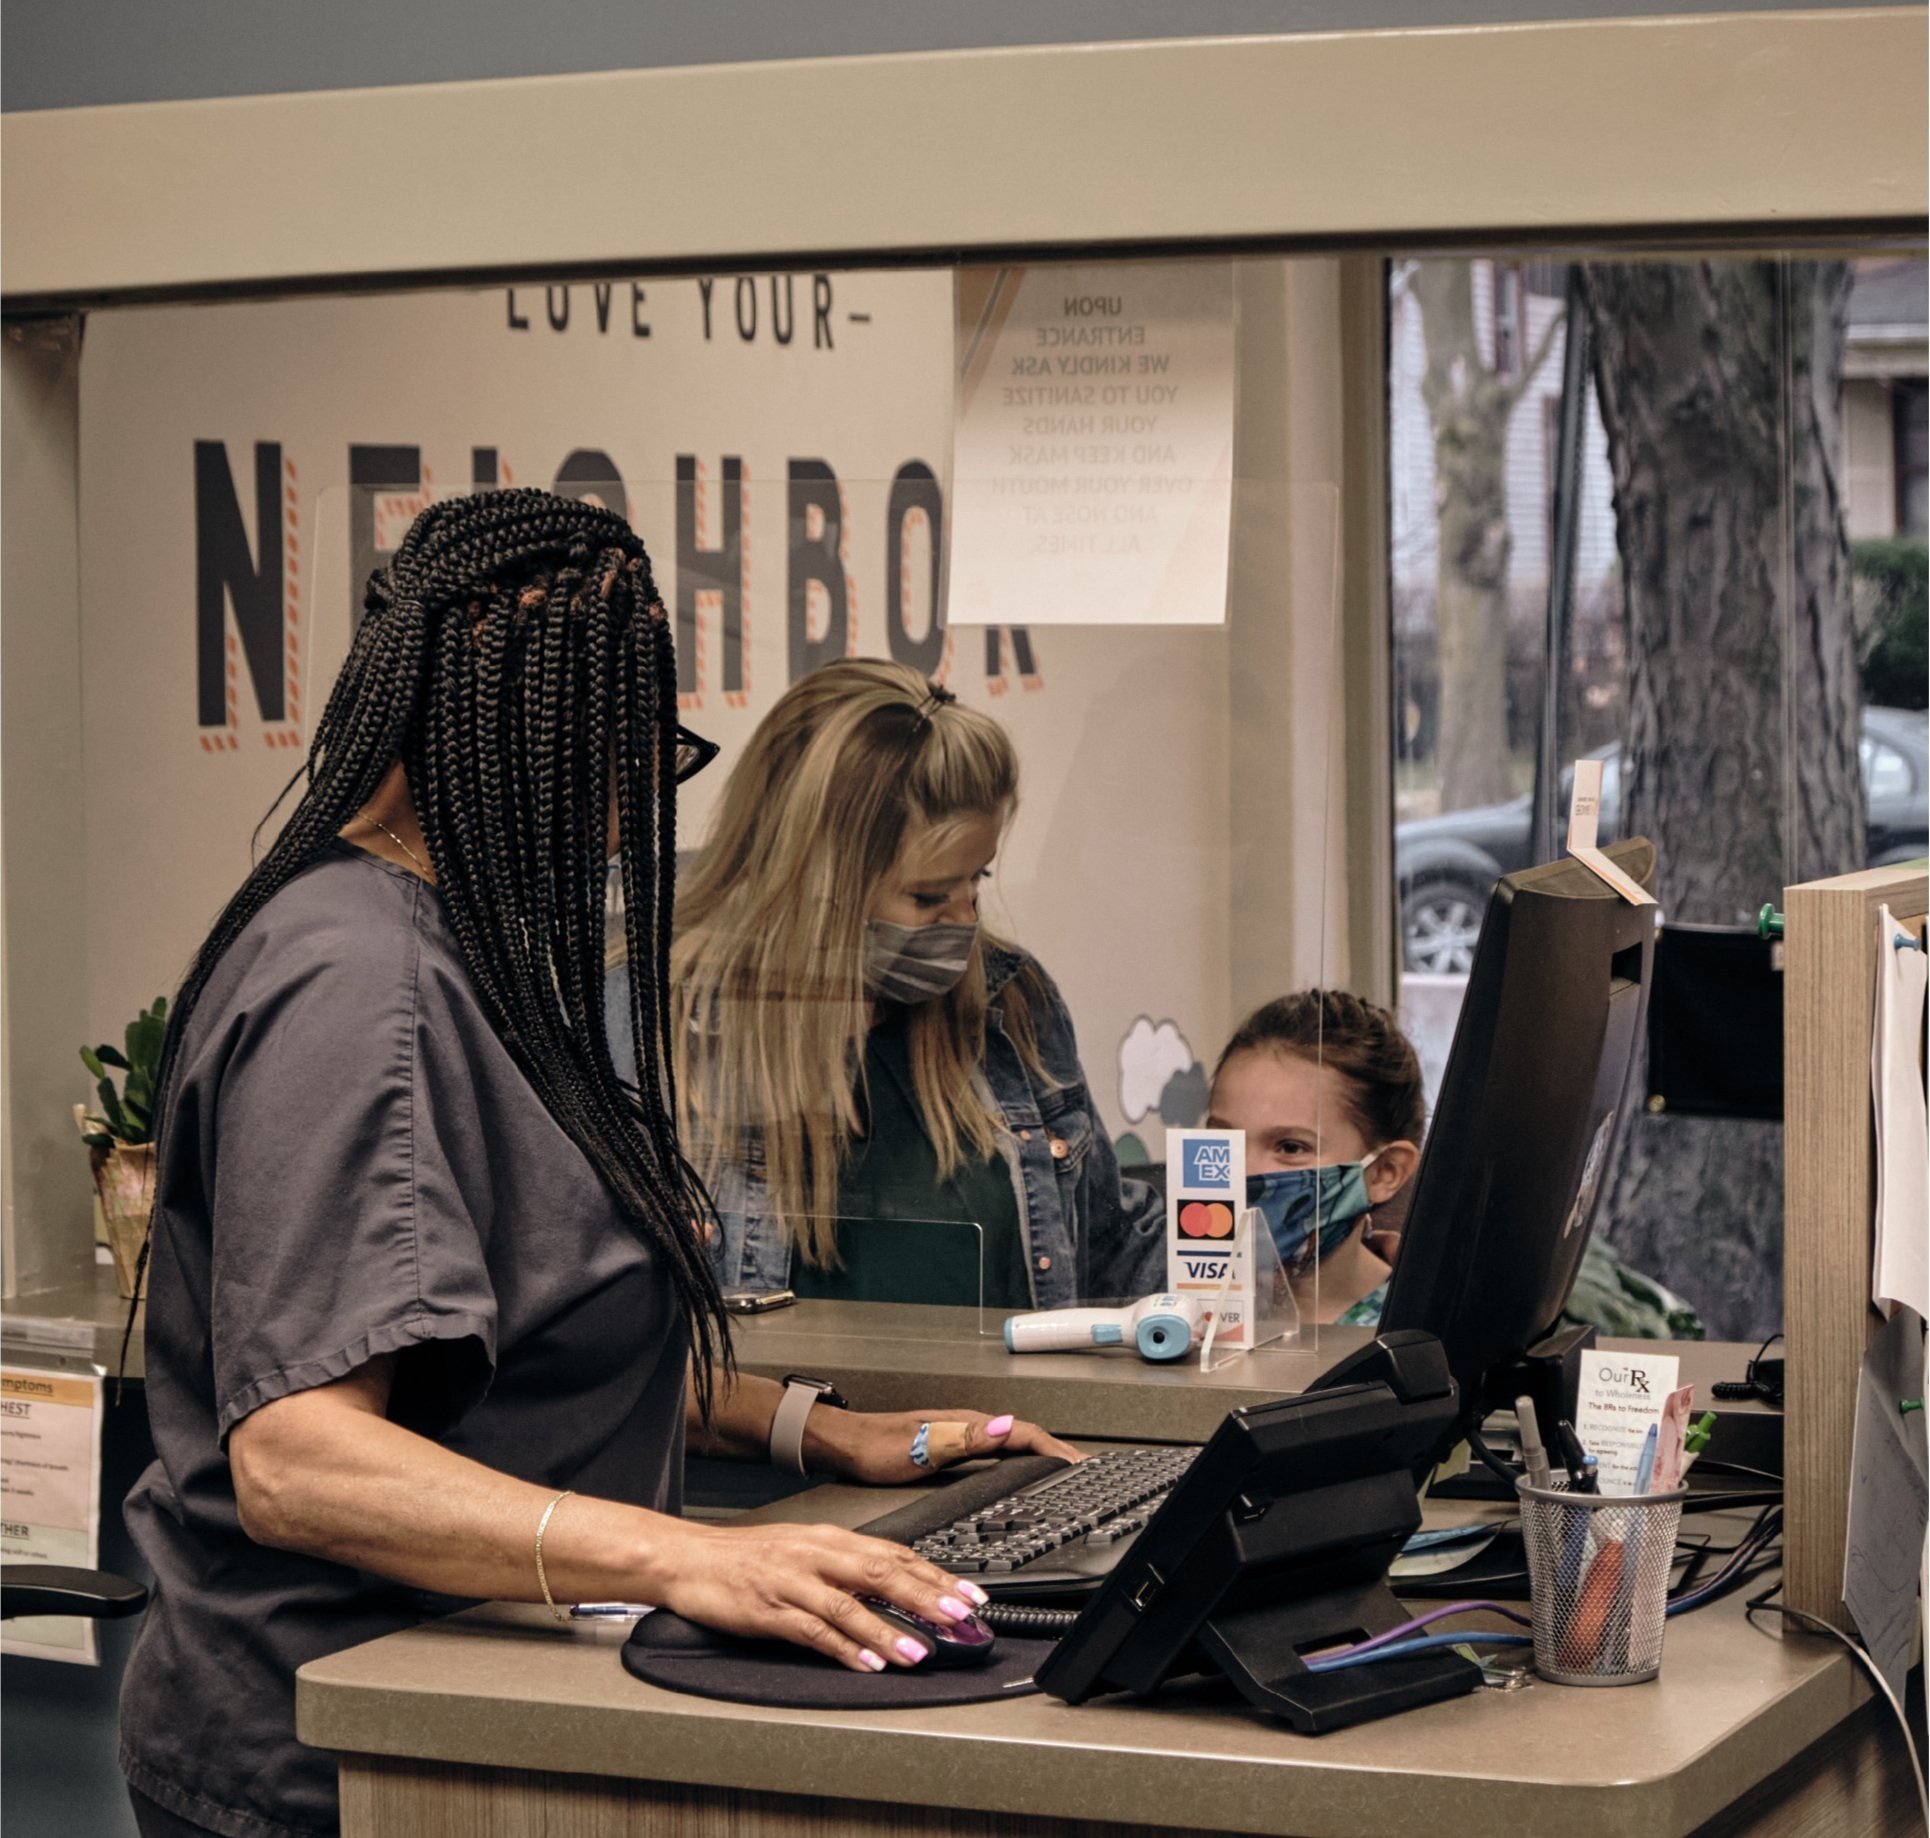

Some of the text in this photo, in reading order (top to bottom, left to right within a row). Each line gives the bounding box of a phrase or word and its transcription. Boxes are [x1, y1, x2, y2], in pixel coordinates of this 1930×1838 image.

[1598, 1367, 1629, 1383] Our
[1606, 1389, 1652, 1401] Wholeness
[1589, 1401, 1602, 1410] The
[1627, 1405, 1660, 1414] Freedom
